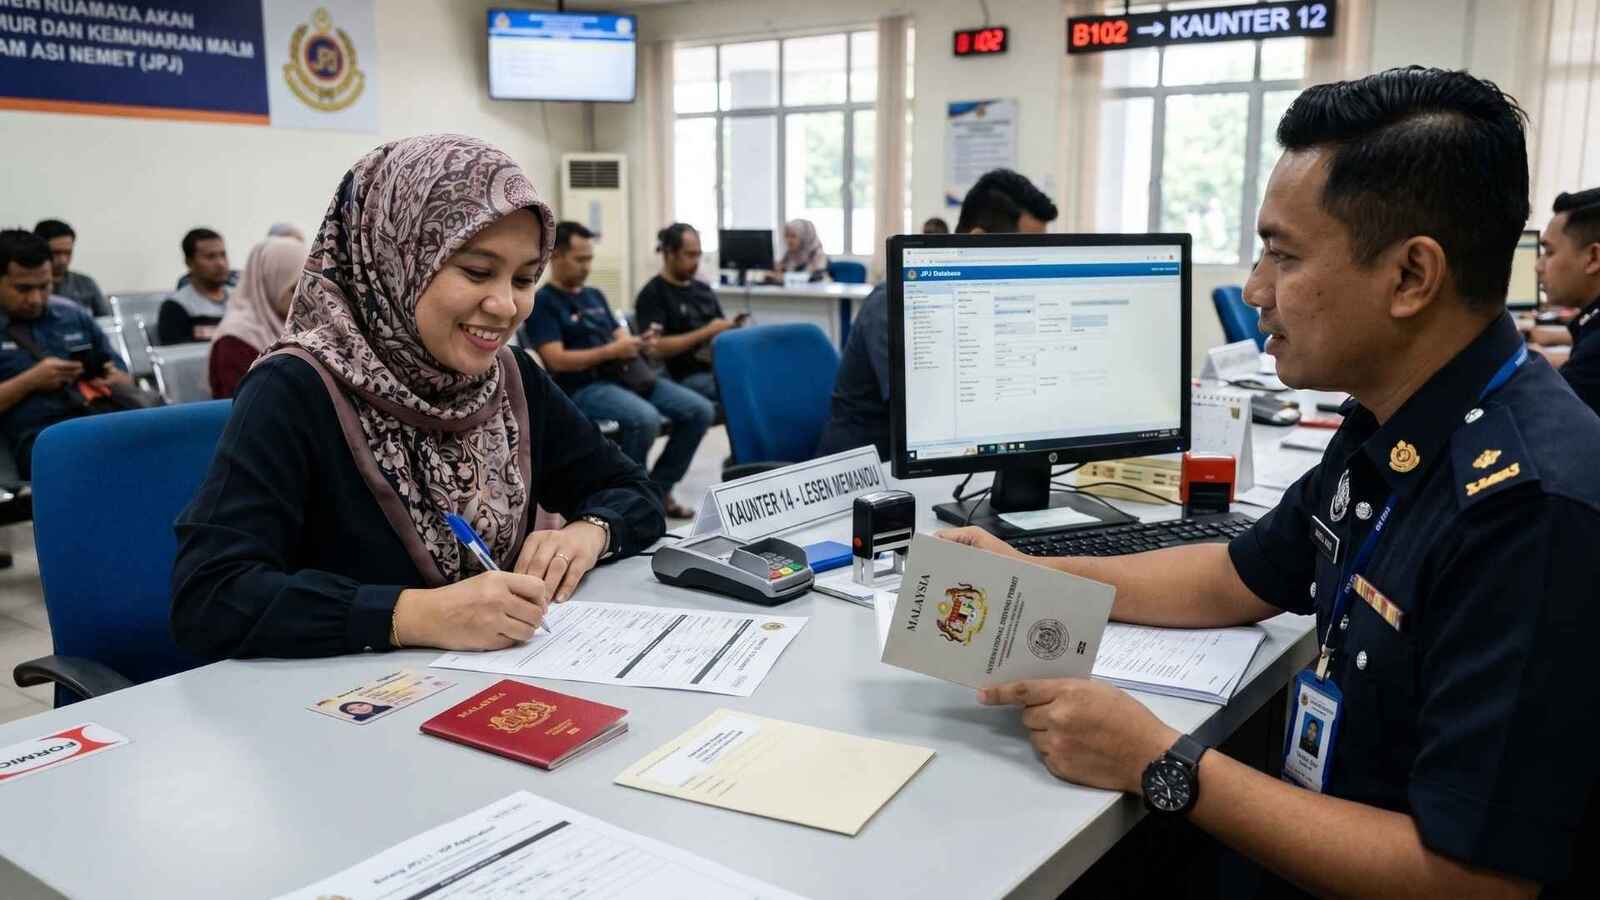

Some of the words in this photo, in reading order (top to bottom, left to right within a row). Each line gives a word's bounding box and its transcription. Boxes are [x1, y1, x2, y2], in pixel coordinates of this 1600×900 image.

[41, 18, 83, 40] DAN
[145, 7, 194, 29] AKAN
[1073, 20, 1129, 47] B102
[1170, 7, 1290, 39] KAUNTER
[1297, 4, 1327, 29] 12
[31, 41, 65, 61] ASI
[69, 45, 136, 68] NEMET
[140, 52, 184, 75] (JPJ)
[920, 270, 932, 278] JPJ
[933, 269, 961, 277] Database
[726, 492, 781, 527] KAUNTER
[780, 488, 795, 511] 14
[799, 477, 834, 506] LESEN
[831, 465, 880, 497] MEMANDU
[906, 574, 931, 631] MALAYSIA
